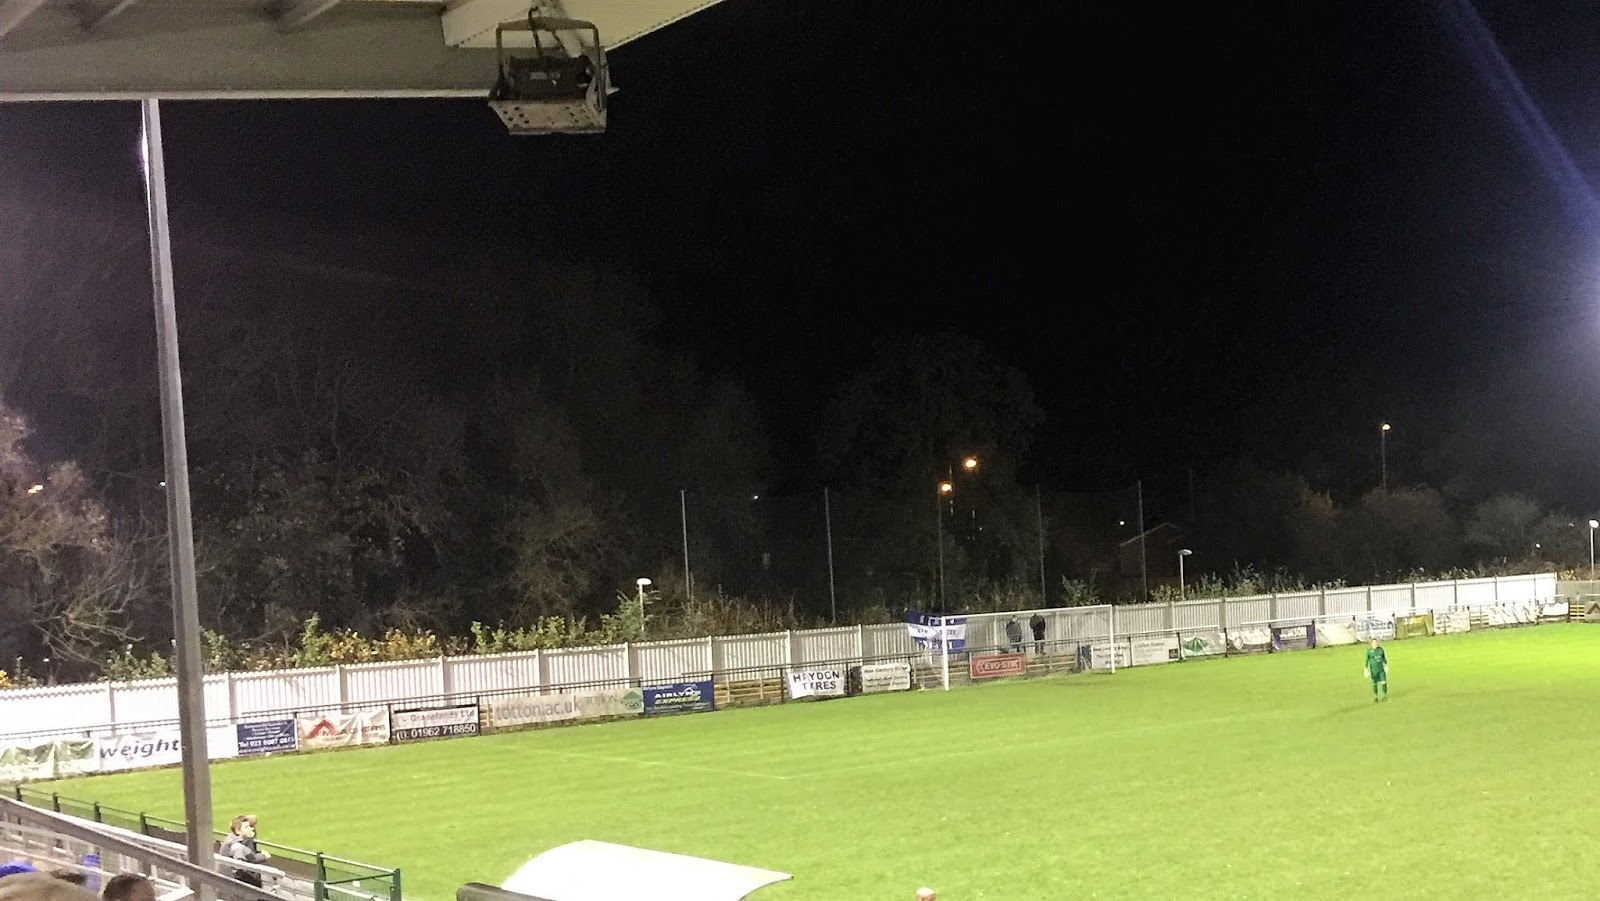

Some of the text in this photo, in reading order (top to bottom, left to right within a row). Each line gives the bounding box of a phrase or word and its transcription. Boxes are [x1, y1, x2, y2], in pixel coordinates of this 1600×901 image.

[793, 671, 840, 683] HAYDON
[496, 695, 581, 721] totton.ac.uk
[410, 726, 441, 738] 01962
[442, 723, 476, 735] 718850
